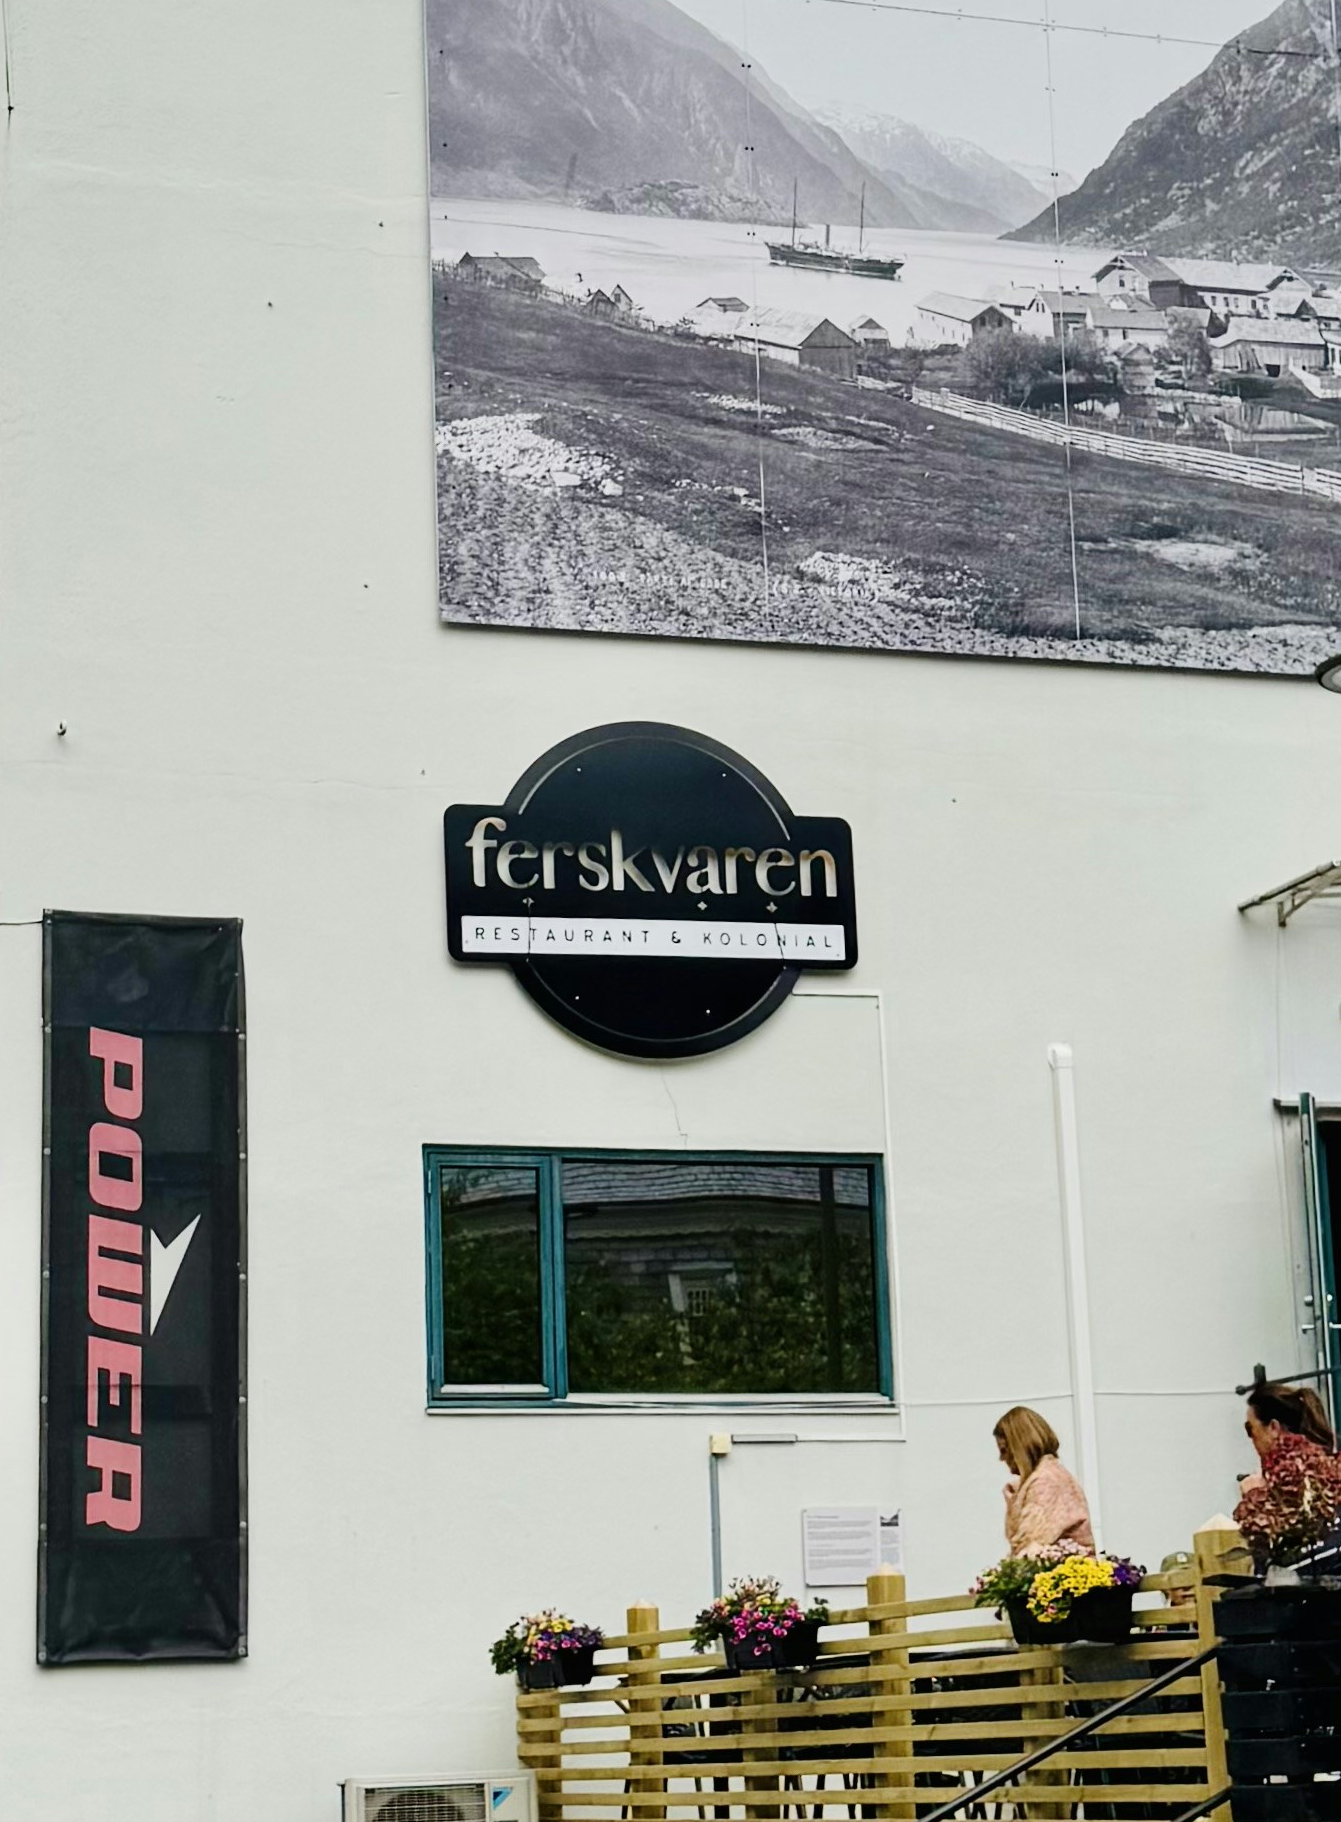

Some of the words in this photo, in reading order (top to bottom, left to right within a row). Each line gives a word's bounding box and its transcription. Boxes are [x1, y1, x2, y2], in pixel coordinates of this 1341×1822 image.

[464, 816, 838, 898] ferskvaren
[475, 927, 650, 944] RESTAURANT
[671, 930, 682, 945] &
[703, 932, 833, 949] KOLONIAL
[85, 1026, 144, 1534] POWER
